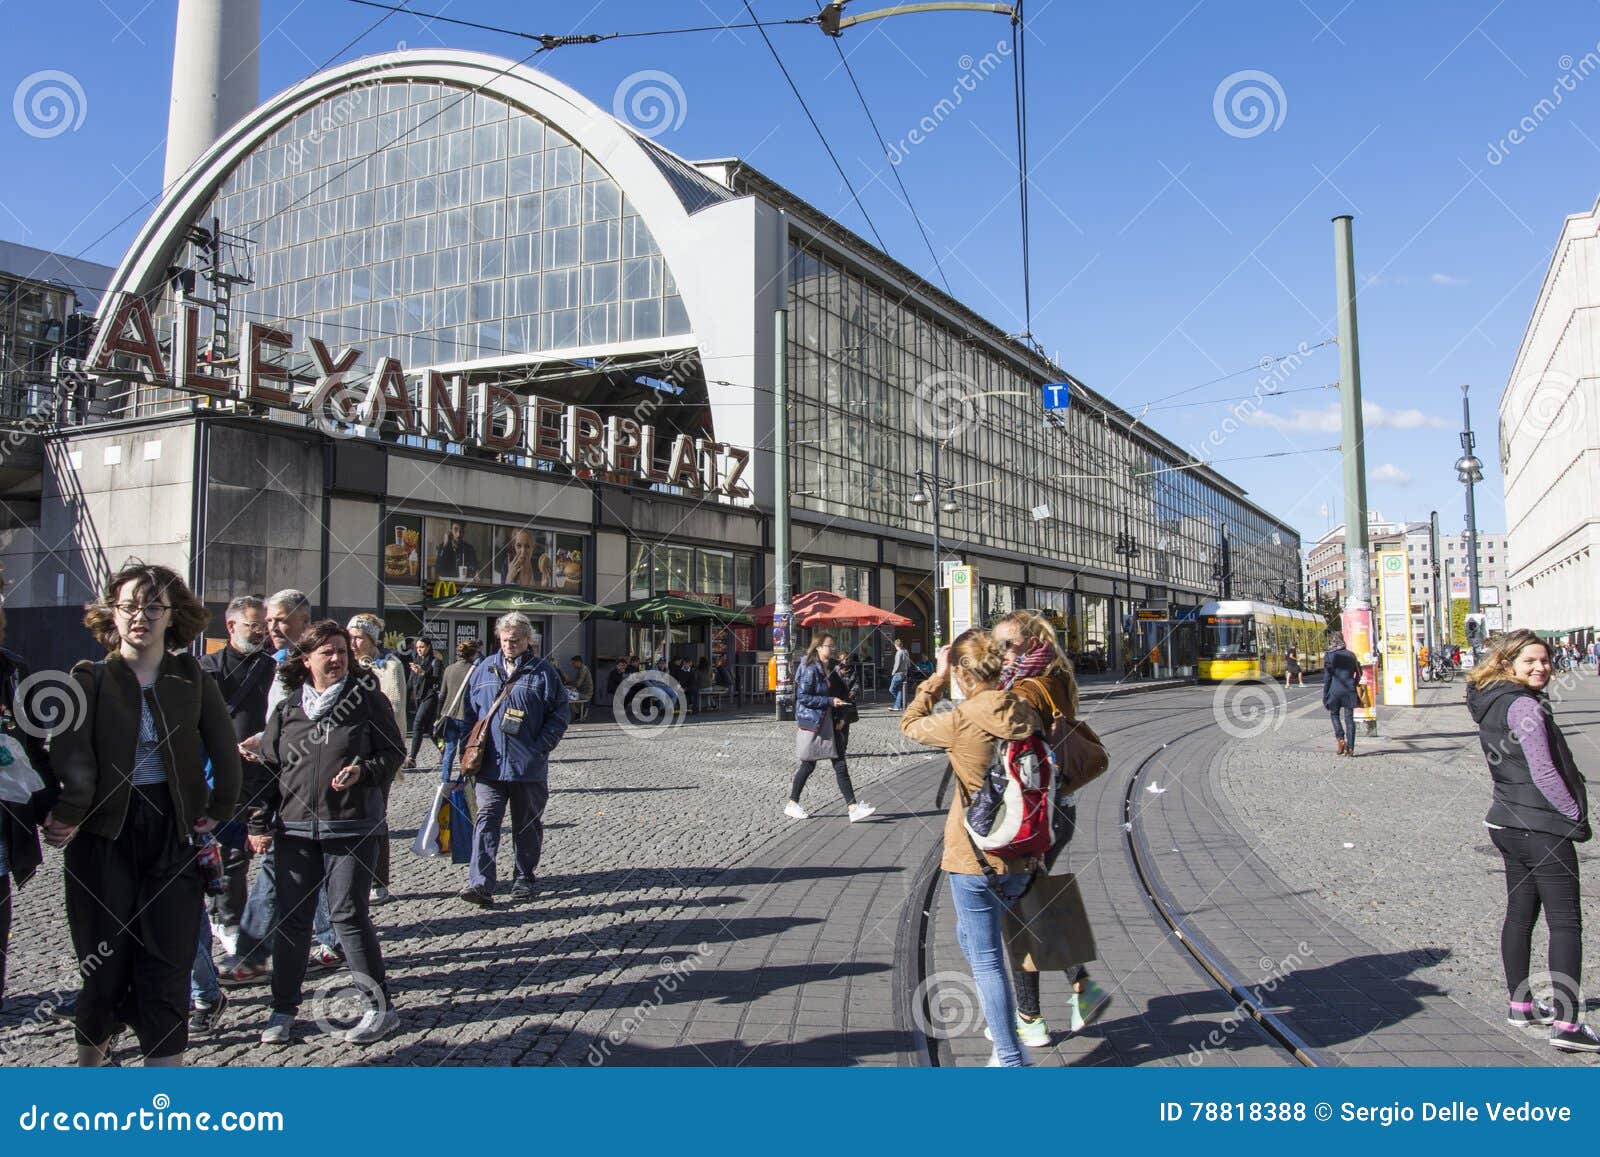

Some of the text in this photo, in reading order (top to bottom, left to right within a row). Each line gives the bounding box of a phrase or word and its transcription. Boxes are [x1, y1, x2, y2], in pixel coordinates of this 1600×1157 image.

[84, 290, 750, 499] ALEXANDERPLATZ
[1048, 386, 1063, 406] T
[457, 625, 476, 635] AUCH
